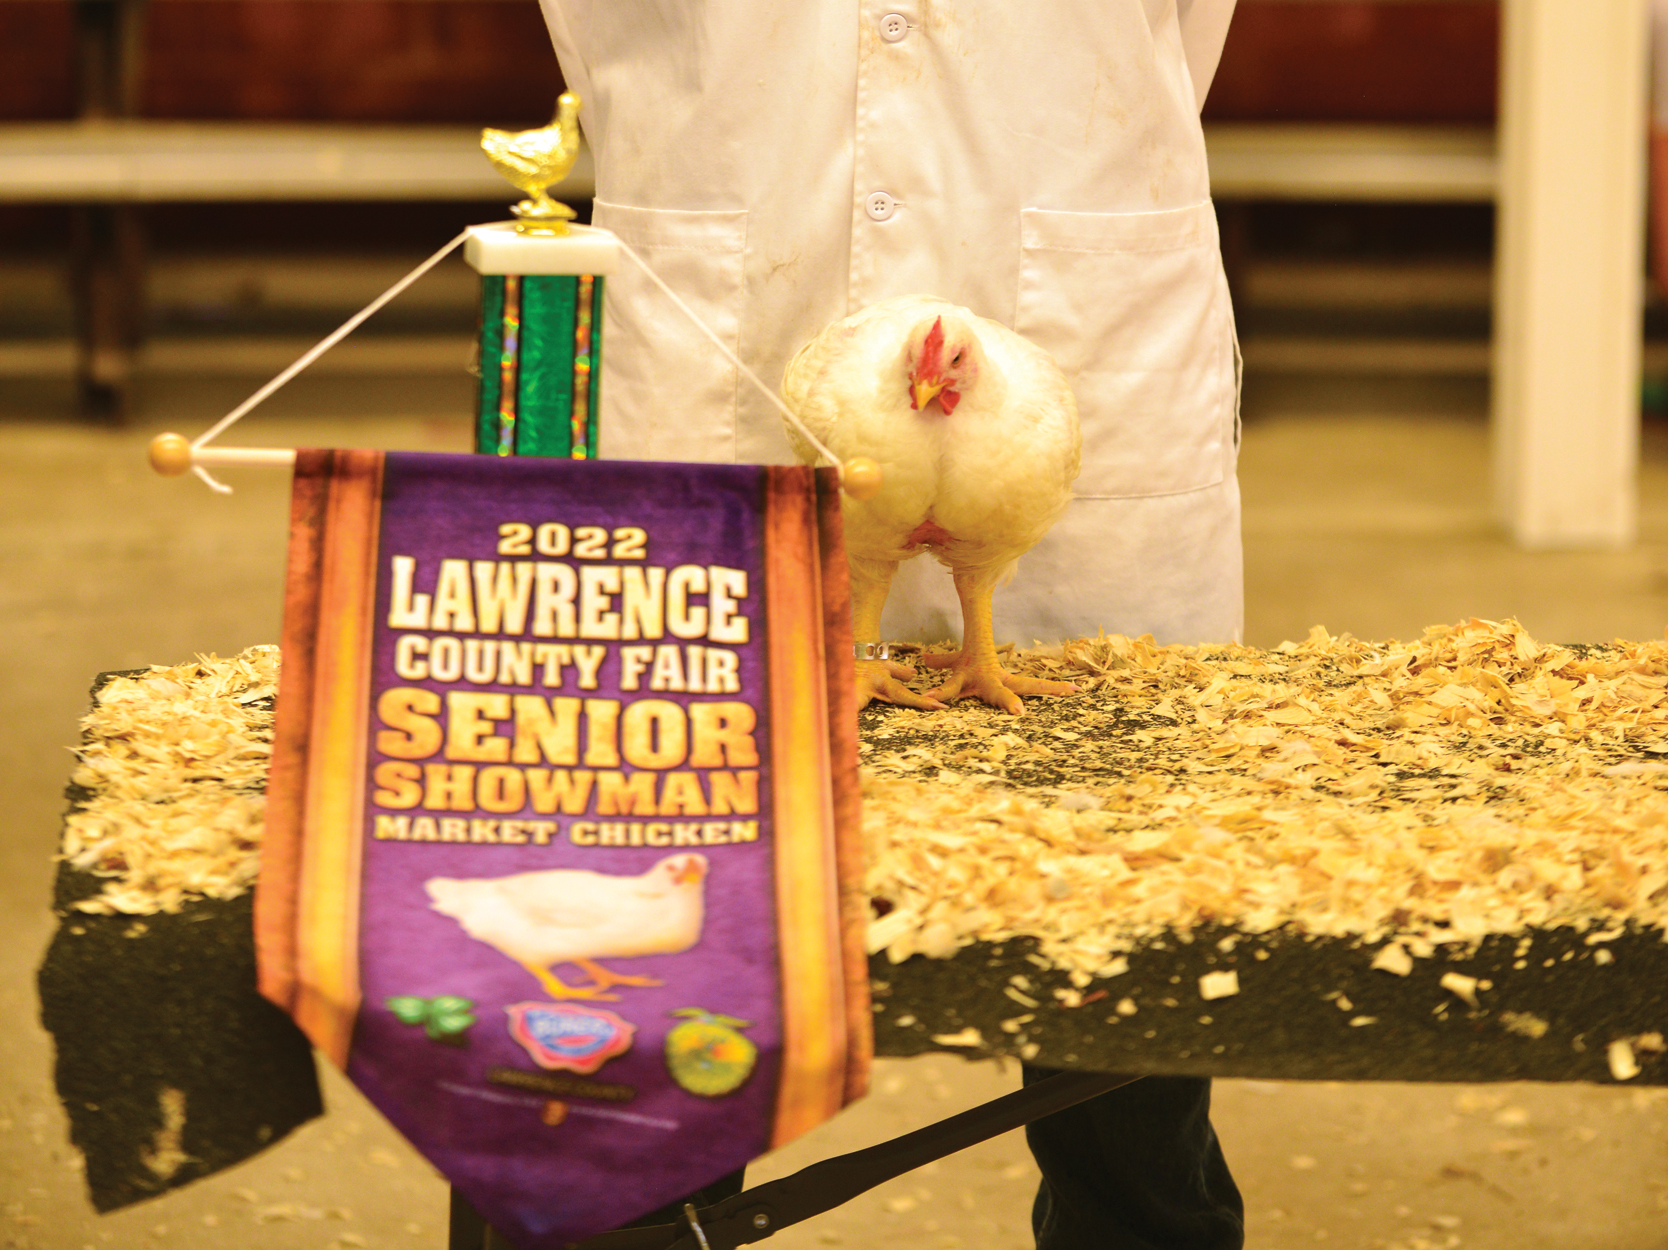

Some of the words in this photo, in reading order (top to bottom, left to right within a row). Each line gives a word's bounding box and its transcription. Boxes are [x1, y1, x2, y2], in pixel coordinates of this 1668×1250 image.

[497, 522, 648, 560] 2022
[387, 555, 750, 644] LAWRENCE
[394, 634, 606, 690] COUNTY
[620, 644, 741, 694] FAIR
[375, 686, 760, 770] SENIOR
[372, 760, 760, 817] SHOWMAN
[373, 815, 558, 845] MARKET
[569, 819, 760, 847] CHICKEN
